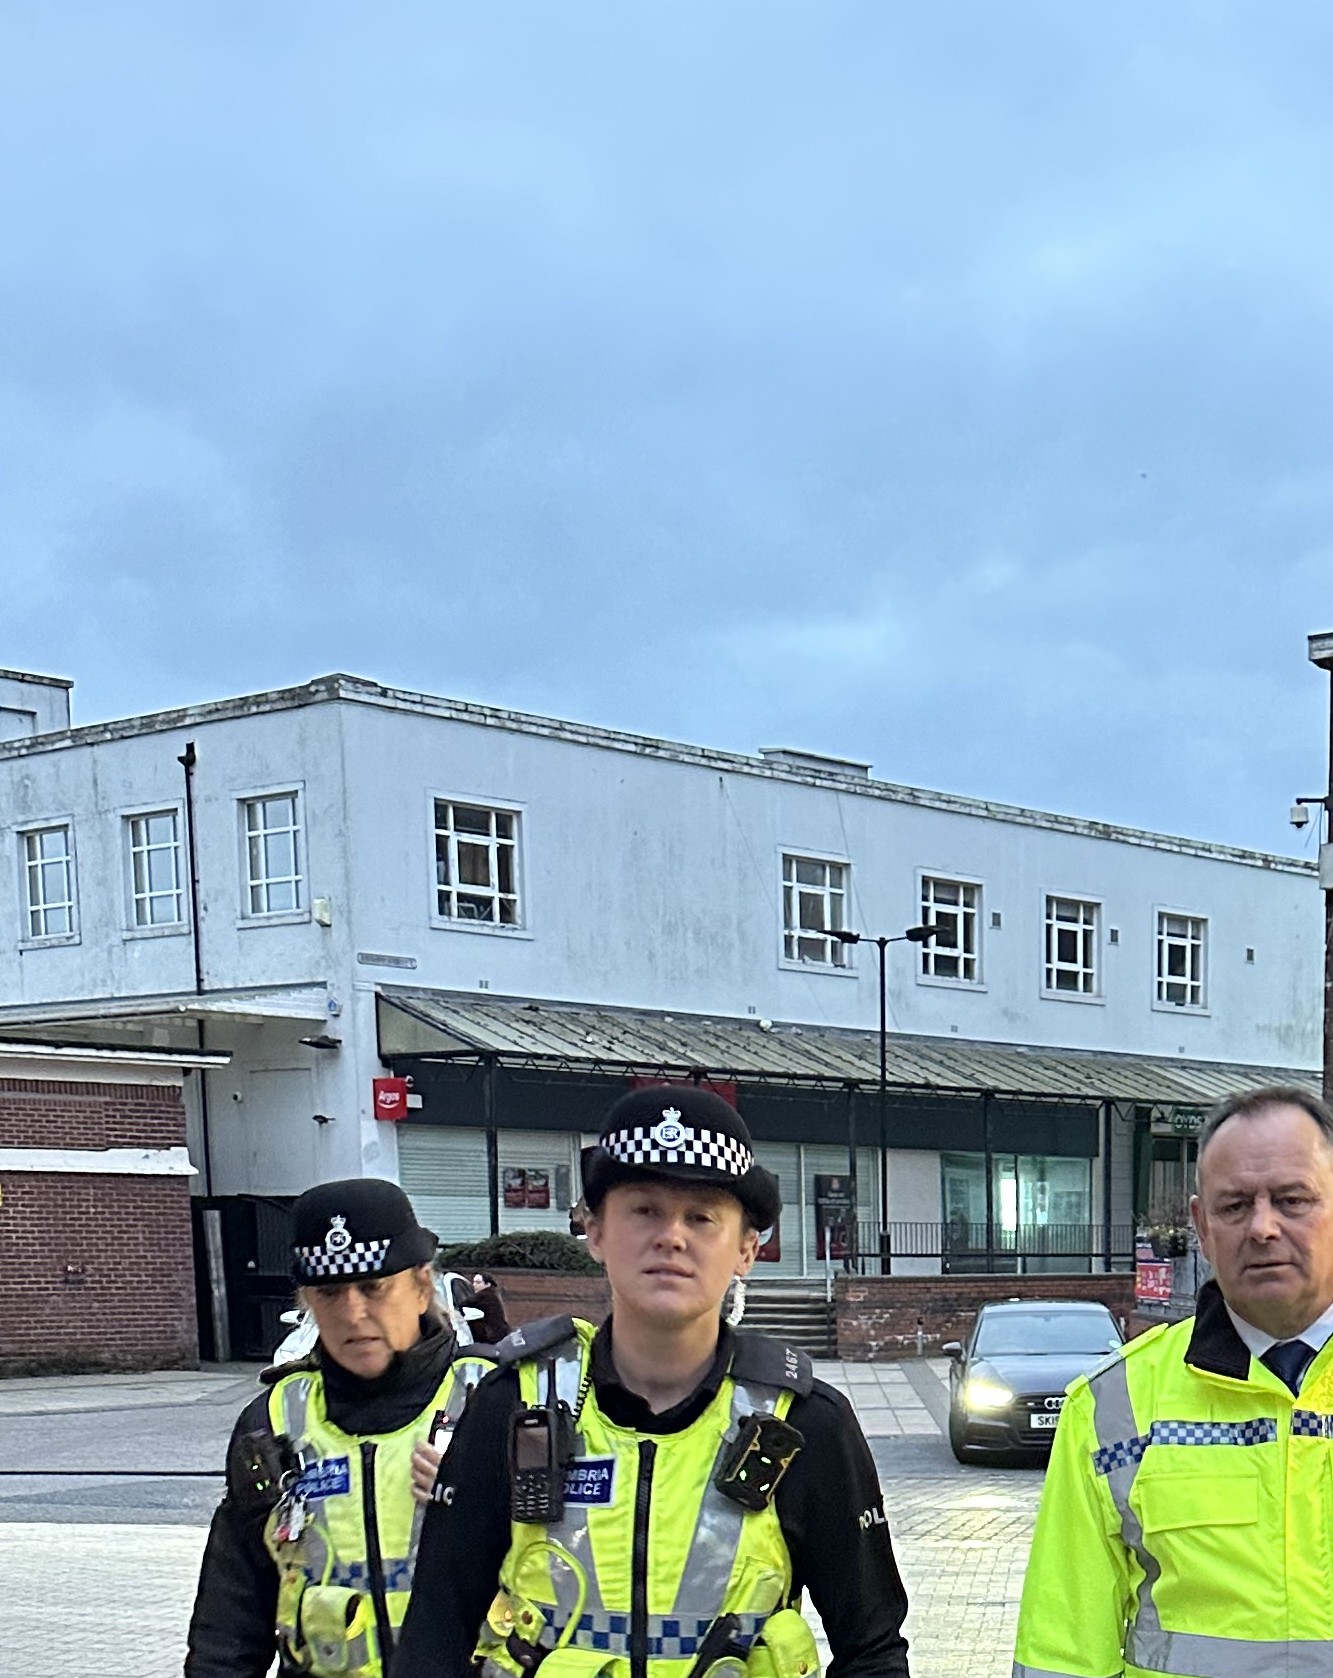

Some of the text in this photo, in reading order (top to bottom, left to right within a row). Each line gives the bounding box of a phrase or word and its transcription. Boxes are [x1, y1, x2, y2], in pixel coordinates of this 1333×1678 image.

[379, 1090, 400, 1104] Argos
[567, 1467, 610, 1482] MBRIA
[563, 1482, 602, 1496] OLICE
[859, 1507, 885, 1531] POL
